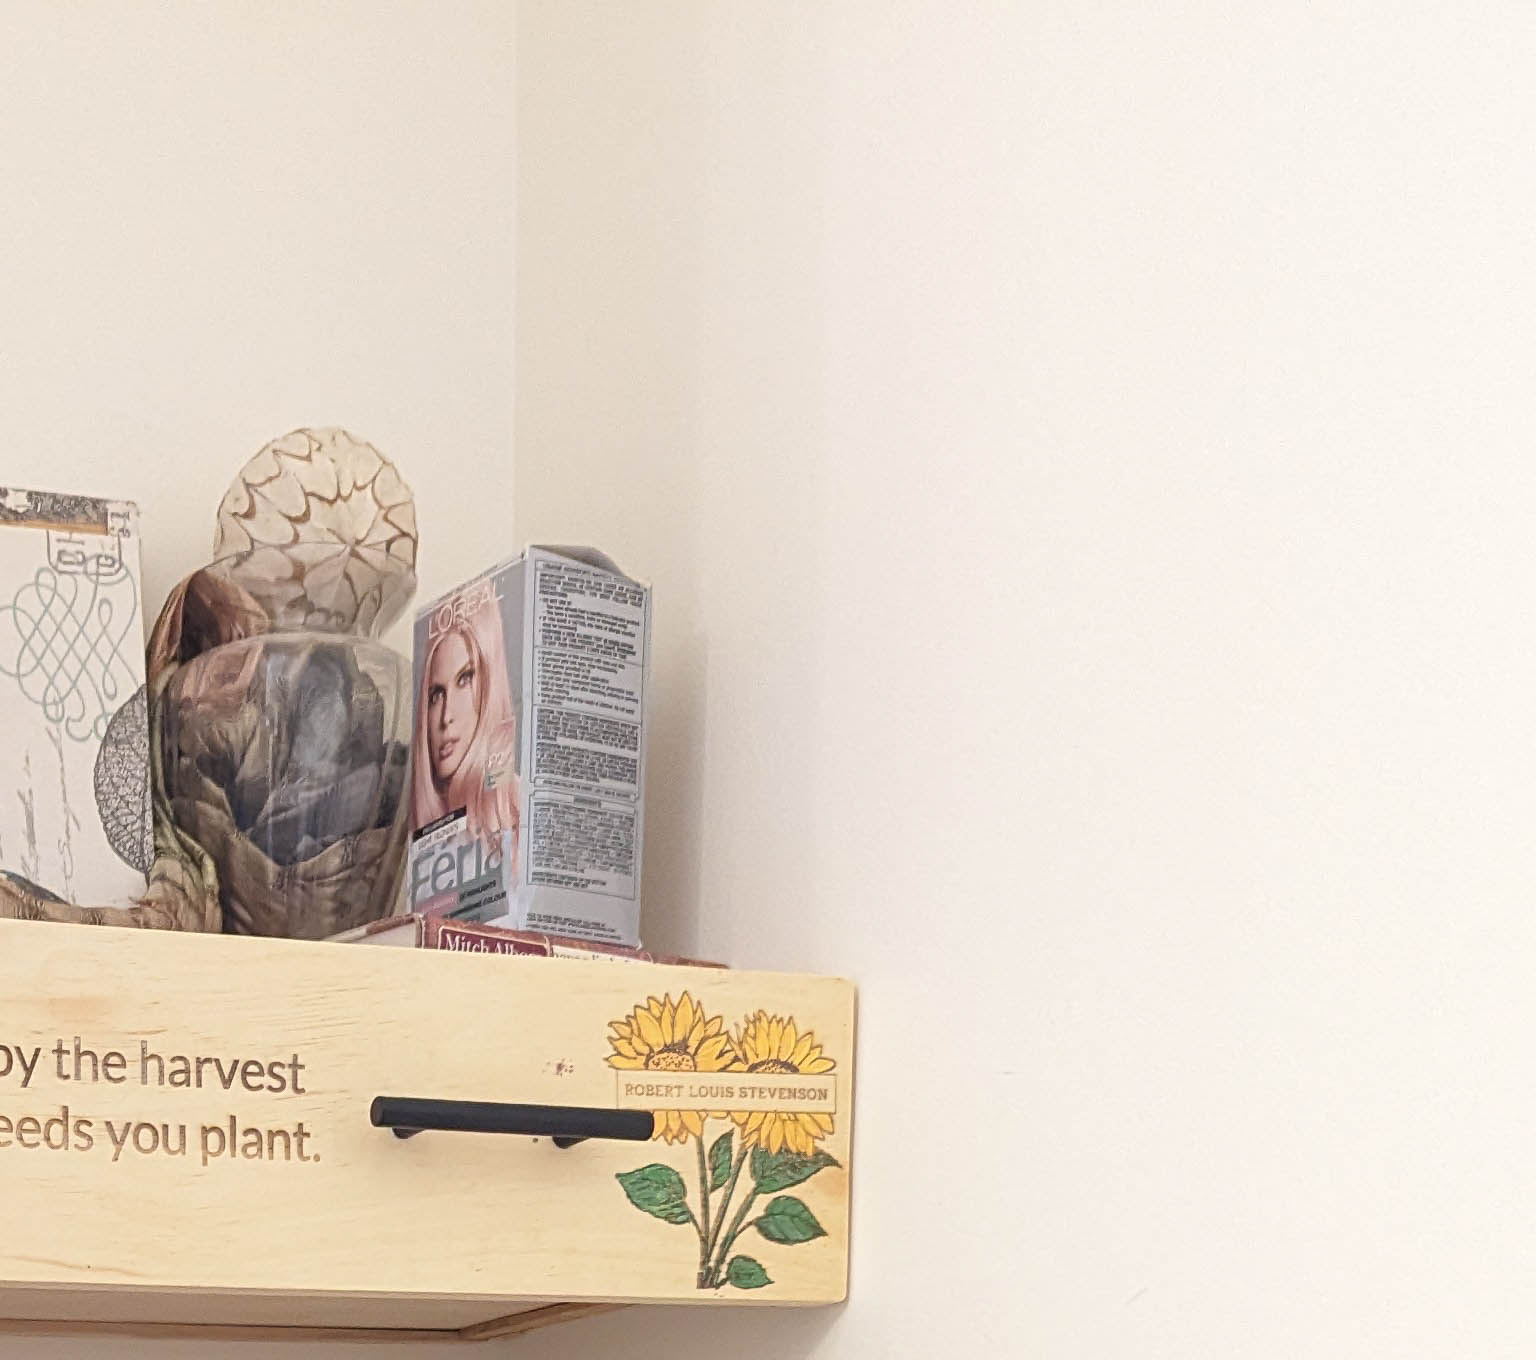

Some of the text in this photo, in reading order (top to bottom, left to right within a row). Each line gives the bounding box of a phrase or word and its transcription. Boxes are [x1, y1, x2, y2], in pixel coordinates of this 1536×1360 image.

[445, 932, 490, 952] Mitch
[494, 940, 543, 957] Alb
[52, 1035, 127, 1084] the
[140, 1039, 306, 1095] harvest
[624, 1082, 829, 1102] ROBERT LOUIS STEVENSON
[104, 1119, 187, 1163] you
[200, 1114, 322, 1167] plant.
